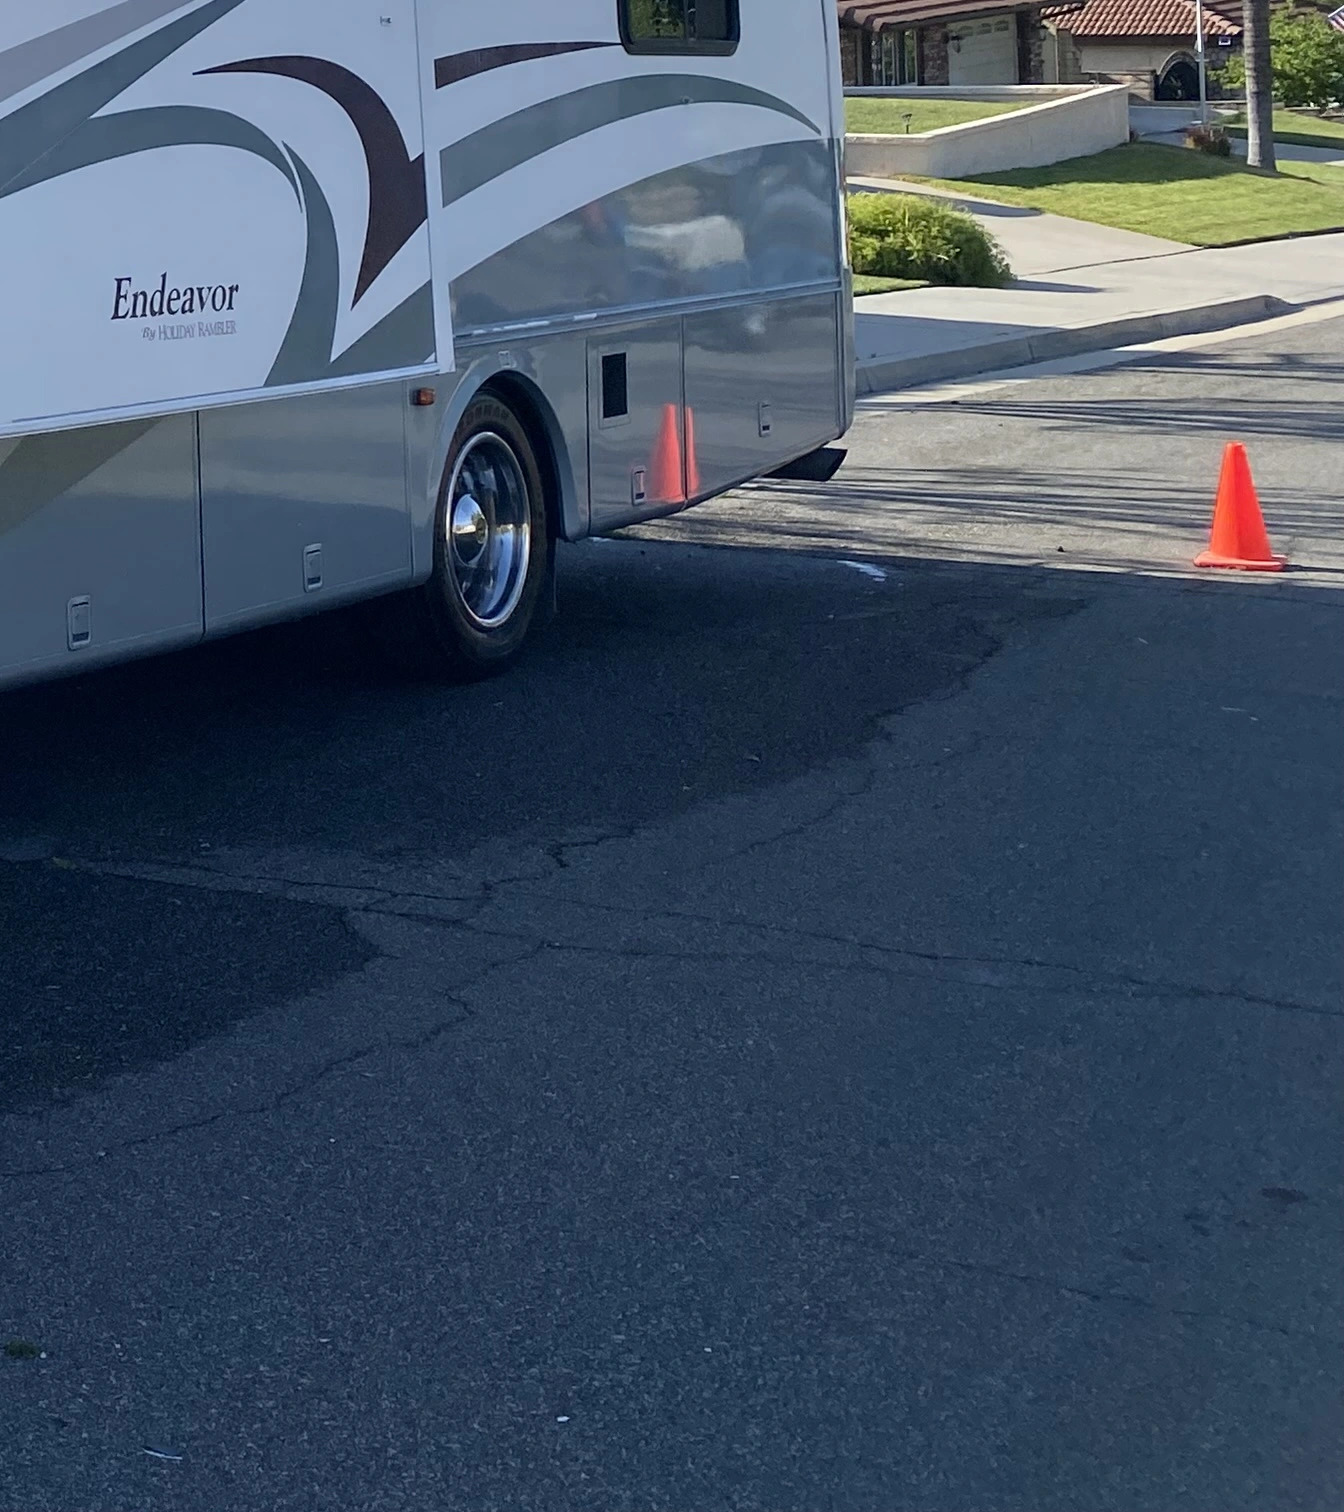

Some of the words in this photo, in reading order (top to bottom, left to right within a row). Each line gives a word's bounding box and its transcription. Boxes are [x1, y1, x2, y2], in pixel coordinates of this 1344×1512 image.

[110, 271, 240, 320] Endeavor
[142, 326, 157, 342] By
[197, 320, 237, 338] RAMBLER
